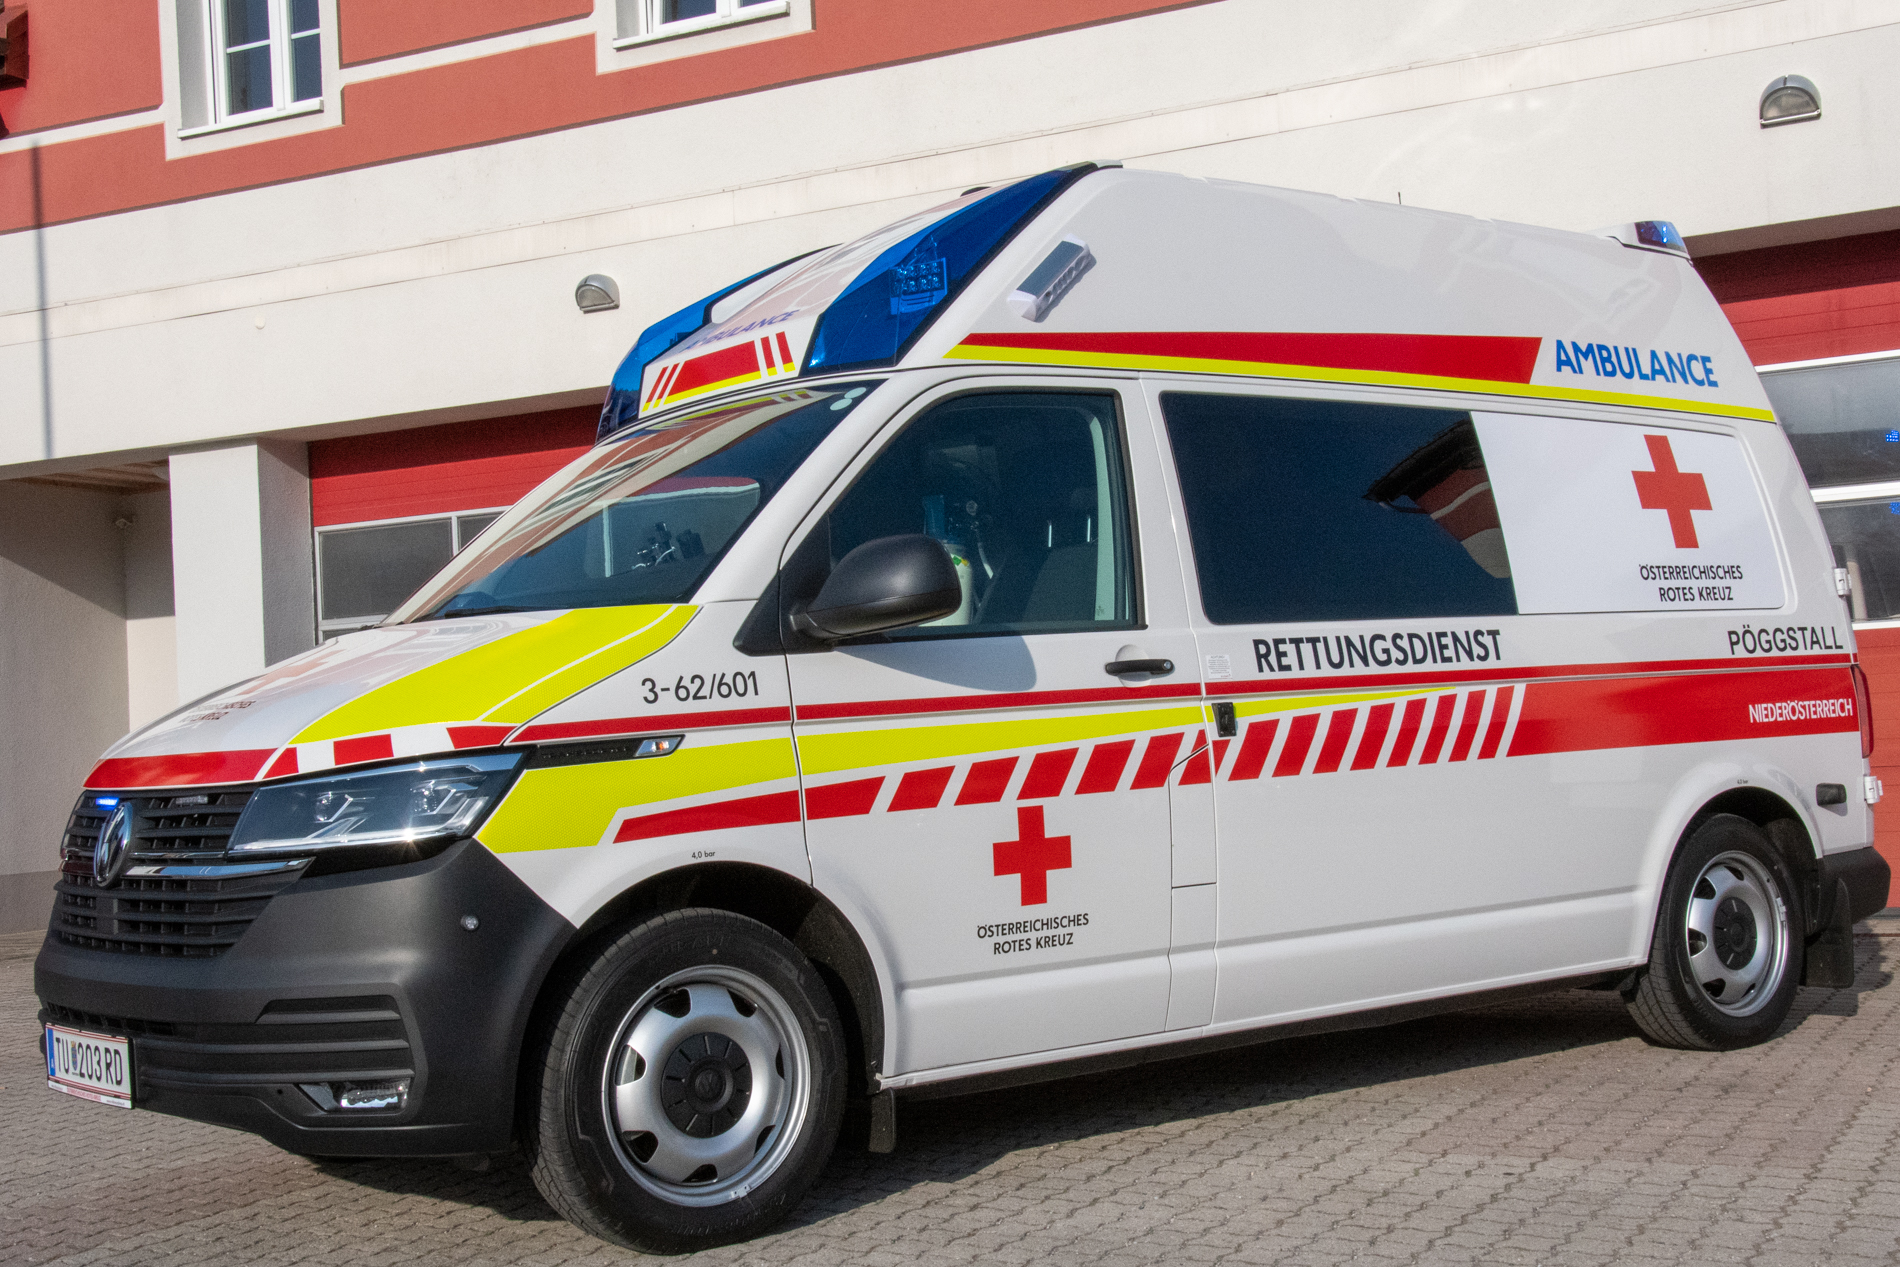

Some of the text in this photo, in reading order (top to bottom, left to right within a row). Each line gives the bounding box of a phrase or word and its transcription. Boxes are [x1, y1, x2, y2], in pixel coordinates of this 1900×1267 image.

[1557, 339, 1719, 388] AMBULANCE
[1639, 564, 1744, 581] ÖSTERREICHISCHES
[1658, 585, 1734, 603] ROTES KREUZ
[1253, 629, 1502, 674] RETTUNGSDIENST
[1727, 624, 1844, 656] PÖGGSTALL
[641, 670, 759, 705] 3-62/601
[1748, 698, 1853, 724] NIEDERÖSTERREICH
[703, 850, 716, 858] bar
[977, 912, 1090, 939] ÖSTERREICHISCHES
[993, 932, 1074, 956] ROTES KREUZ
[55, 1036, 123, 1086] TU 203 RD
